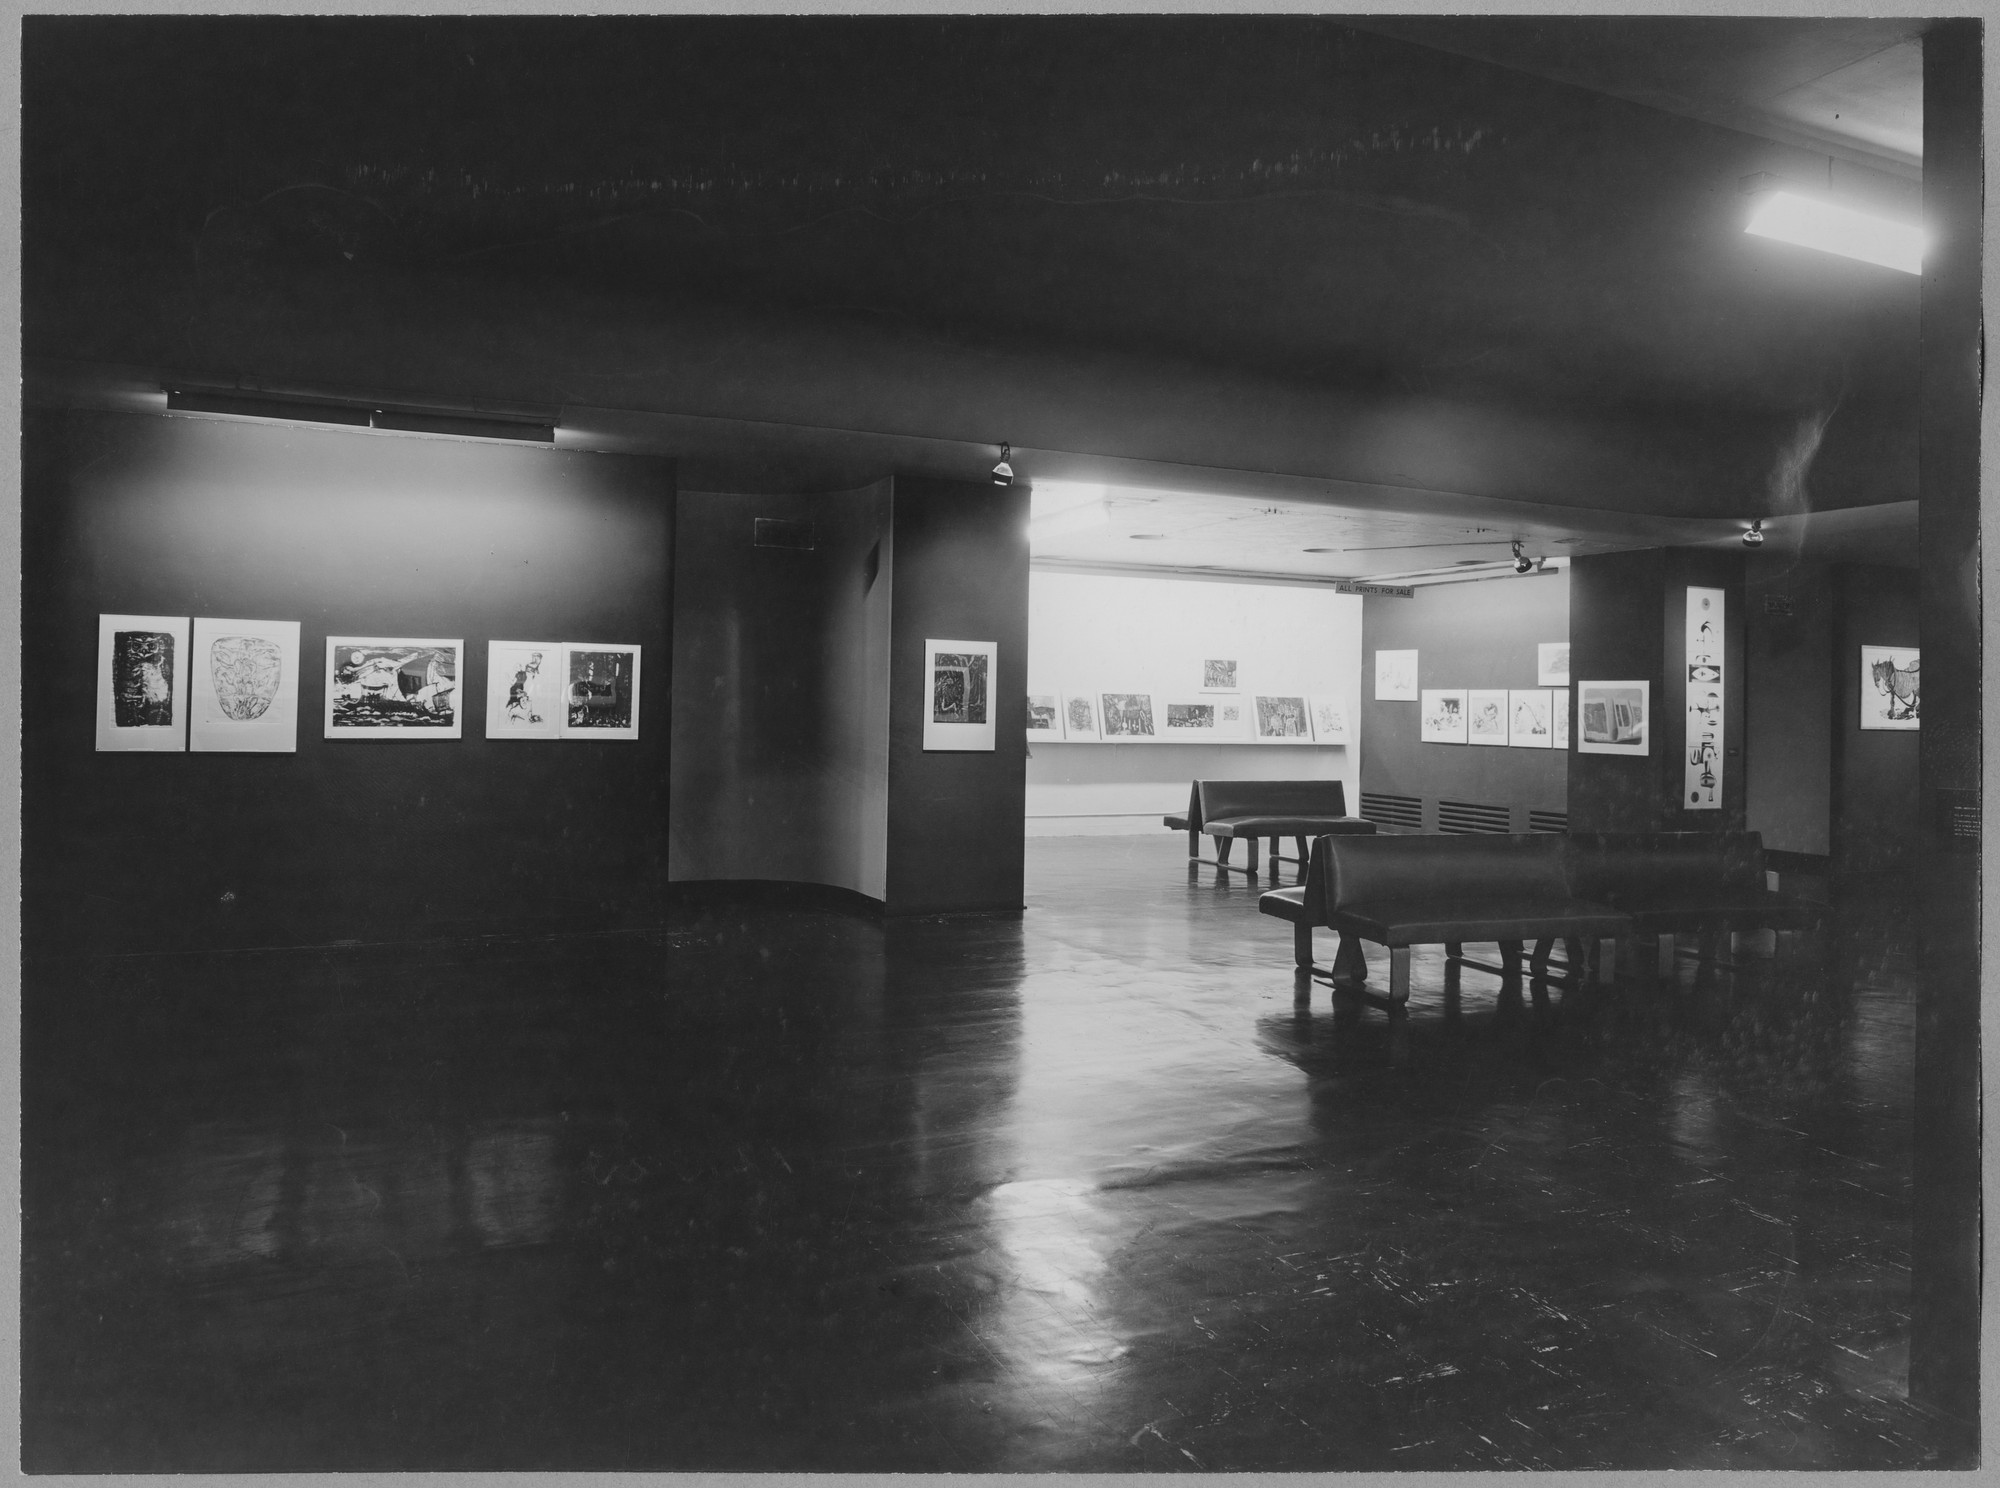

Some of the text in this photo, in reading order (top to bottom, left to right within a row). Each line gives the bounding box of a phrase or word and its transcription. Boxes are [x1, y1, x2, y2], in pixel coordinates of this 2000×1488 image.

[1339, 584, 1411, 596] ALL PRINTS FOR SALE
